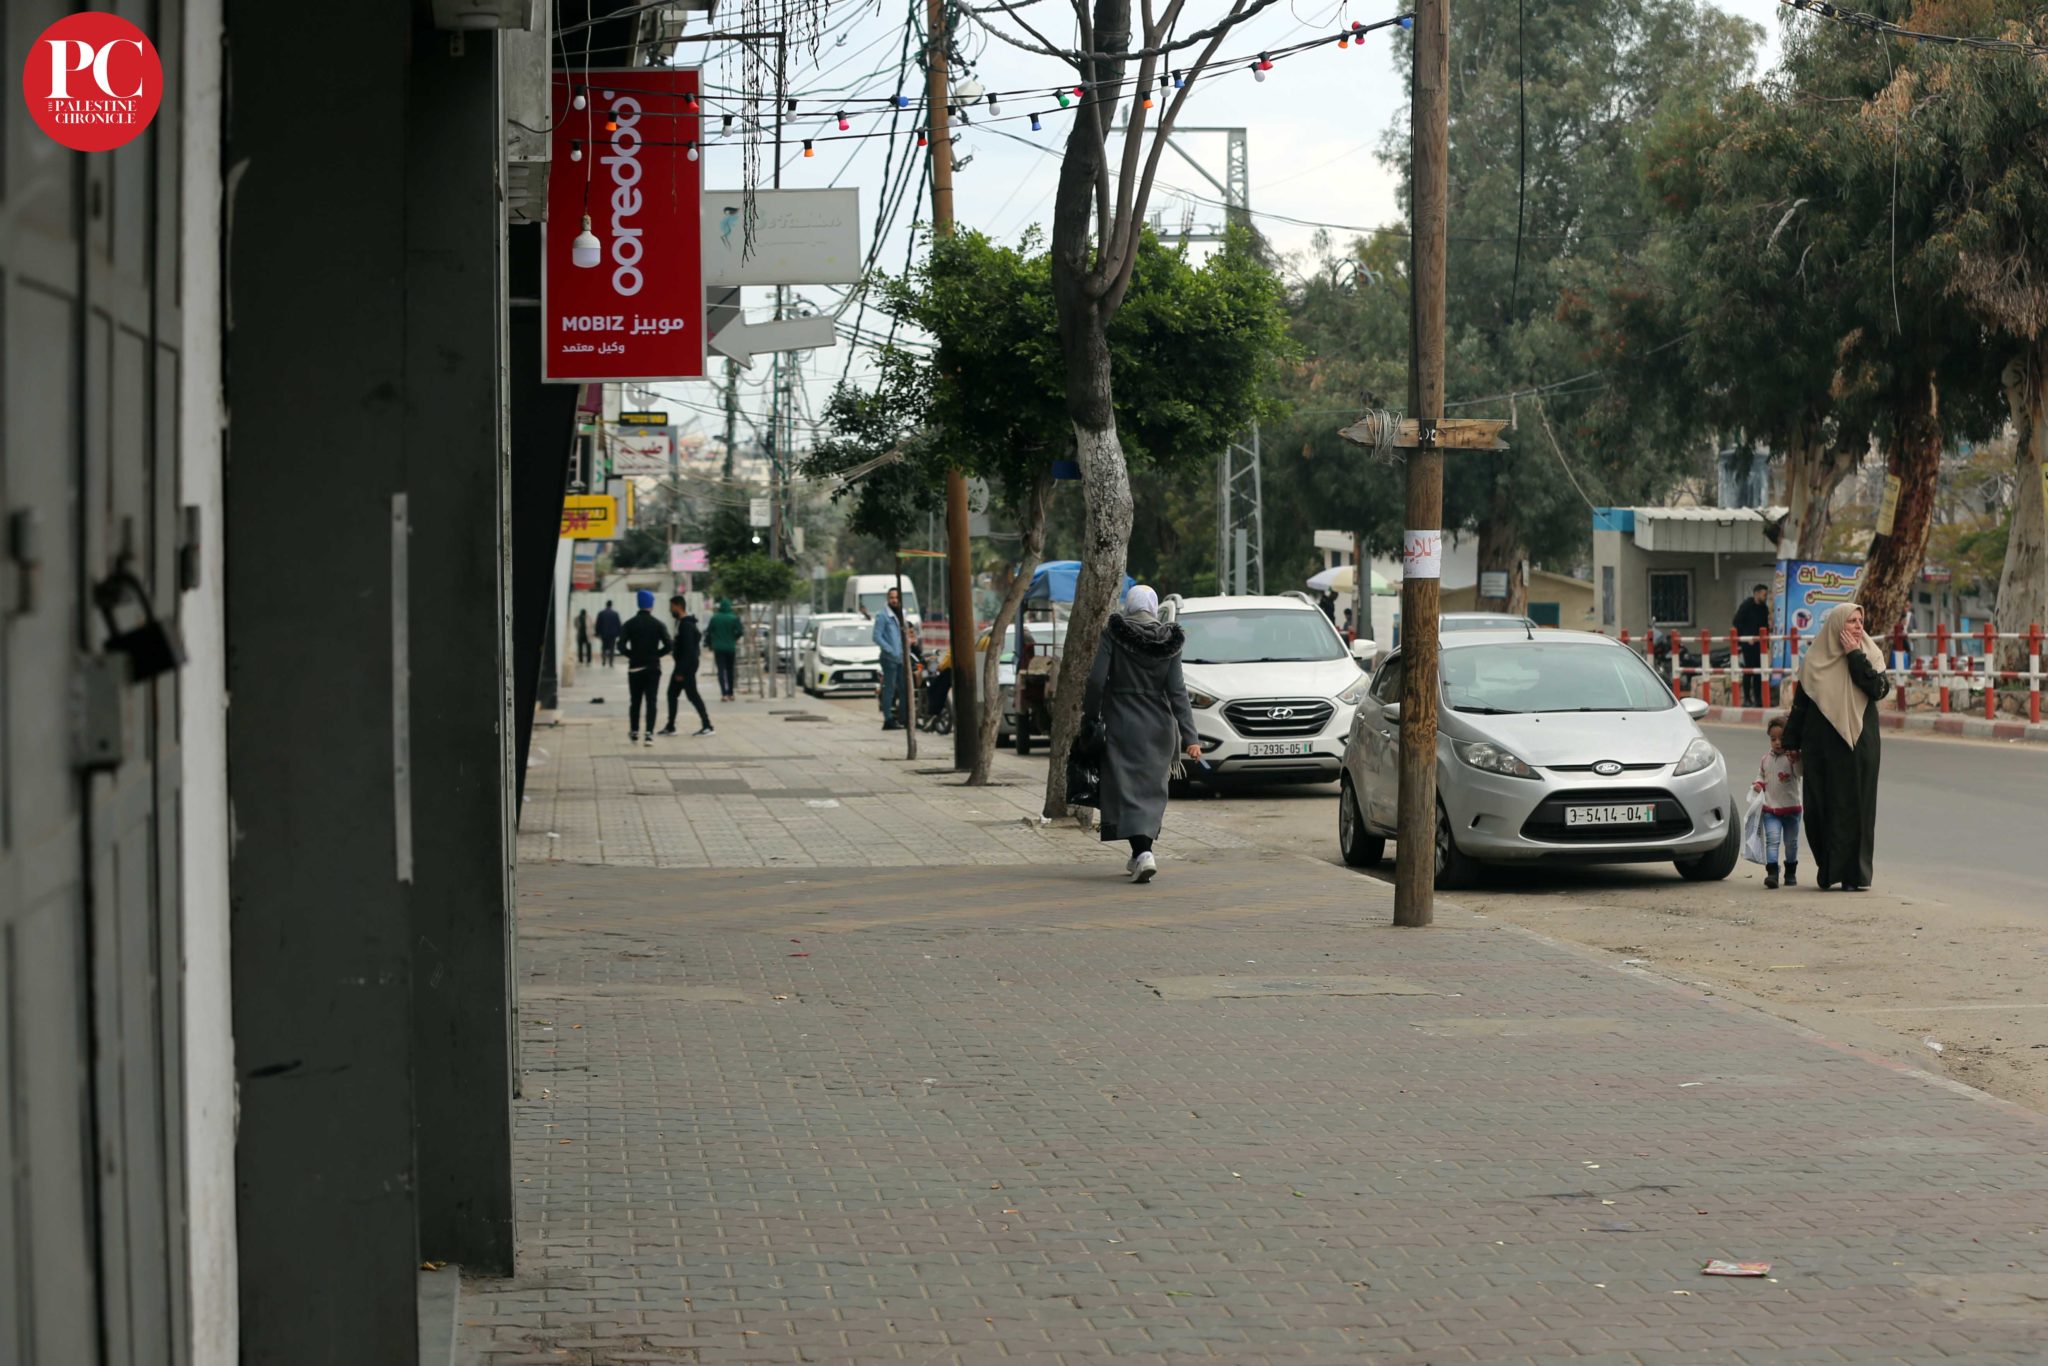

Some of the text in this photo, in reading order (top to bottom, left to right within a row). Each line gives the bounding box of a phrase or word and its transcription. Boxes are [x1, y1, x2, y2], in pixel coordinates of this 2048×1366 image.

[600, 96, 644, 297] ooredoo
[562, 316, 625, 331] MOBIZ
[629, 314, 684, 335] موبيز
[562, 341, 625, 354] وكيل معتمد
[1569, 806, 1642, 823] 3-5414-04
